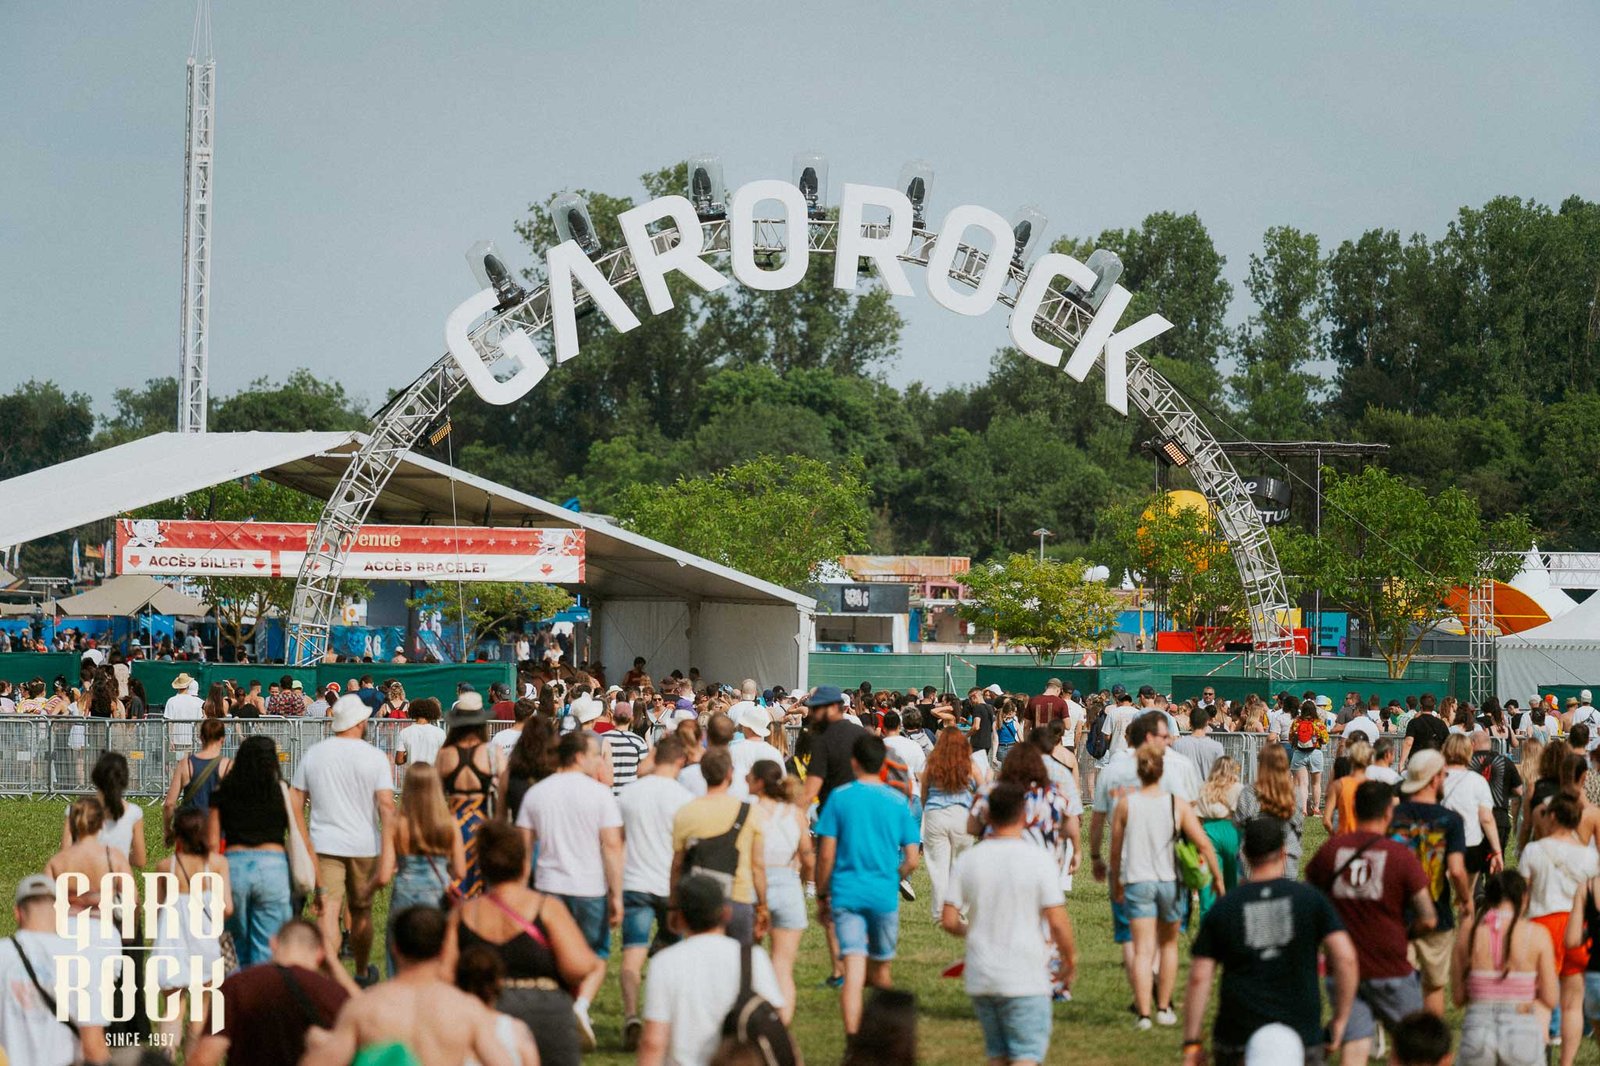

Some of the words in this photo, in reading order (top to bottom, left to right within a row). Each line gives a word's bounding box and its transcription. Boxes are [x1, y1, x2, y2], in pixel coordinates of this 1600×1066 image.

[444, 179, 1174, 416] GAROROCK
[149, 553, 196, 568] ACCÈS
[200, 556, 245, 569] BILLET
[364, 558, 412, 572] ACCÈS
[416, 561, 488, 574] BRACELET
